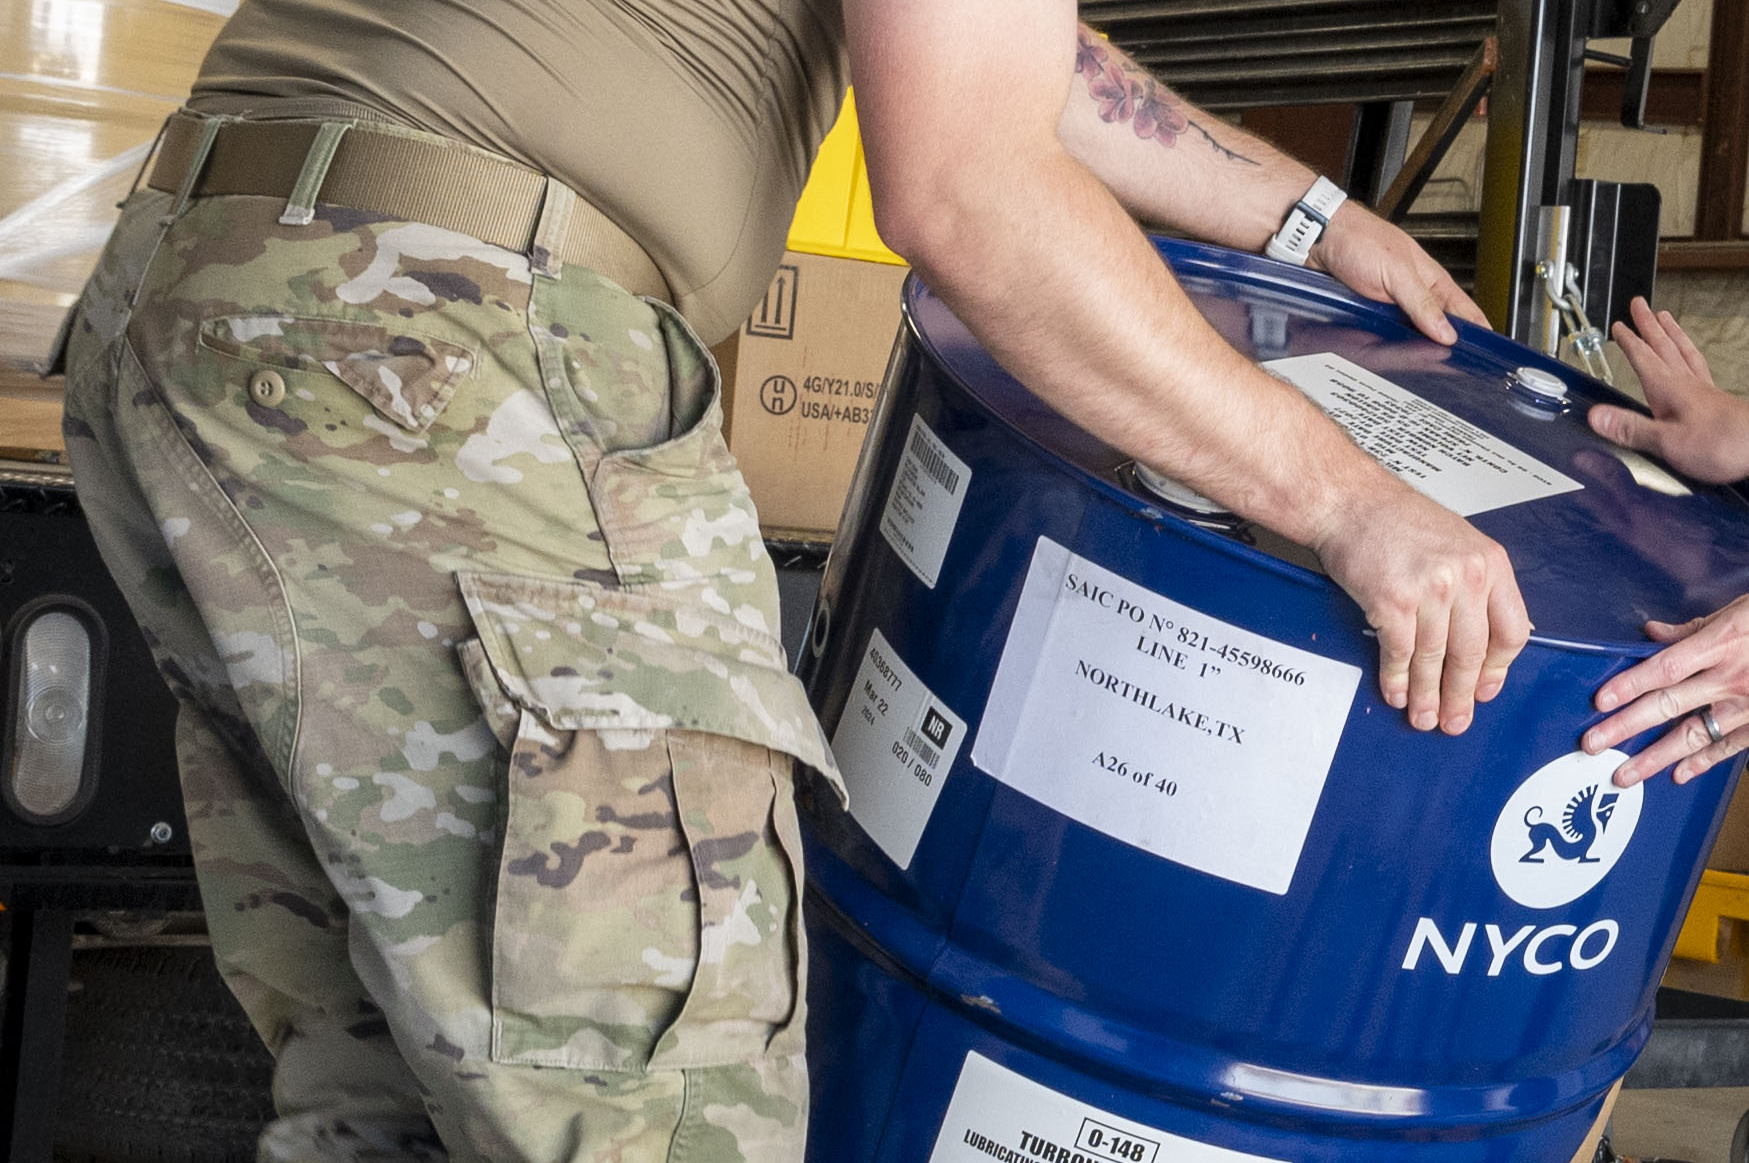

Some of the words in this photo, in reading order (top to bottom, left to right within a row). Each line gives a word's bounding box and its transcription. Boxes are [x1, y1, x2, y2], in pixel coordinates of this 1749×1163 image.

[801, 401, 874, 424] USA/+AB3
[1065, 572, 1114, 610] SAIC
[1117, 598, 1145, 624] PO
[1177, 626, 1307, 687] 821-45598666
[1136, 635, 1189, 671] LINE
[863, 679, 878, 703] Mar
[877, 698, 889, 717] 22
[927, 715, 945, 741] NR
[892, 741, 909, 764] 020
[914, 764, 932, 787] 080
[1092, 750, 1128, 779] A26
[1132, 770, 1154, 788] of
[1155, 778, 1178, 798] 40
[1401, 916, 1619, 977] NYCO
